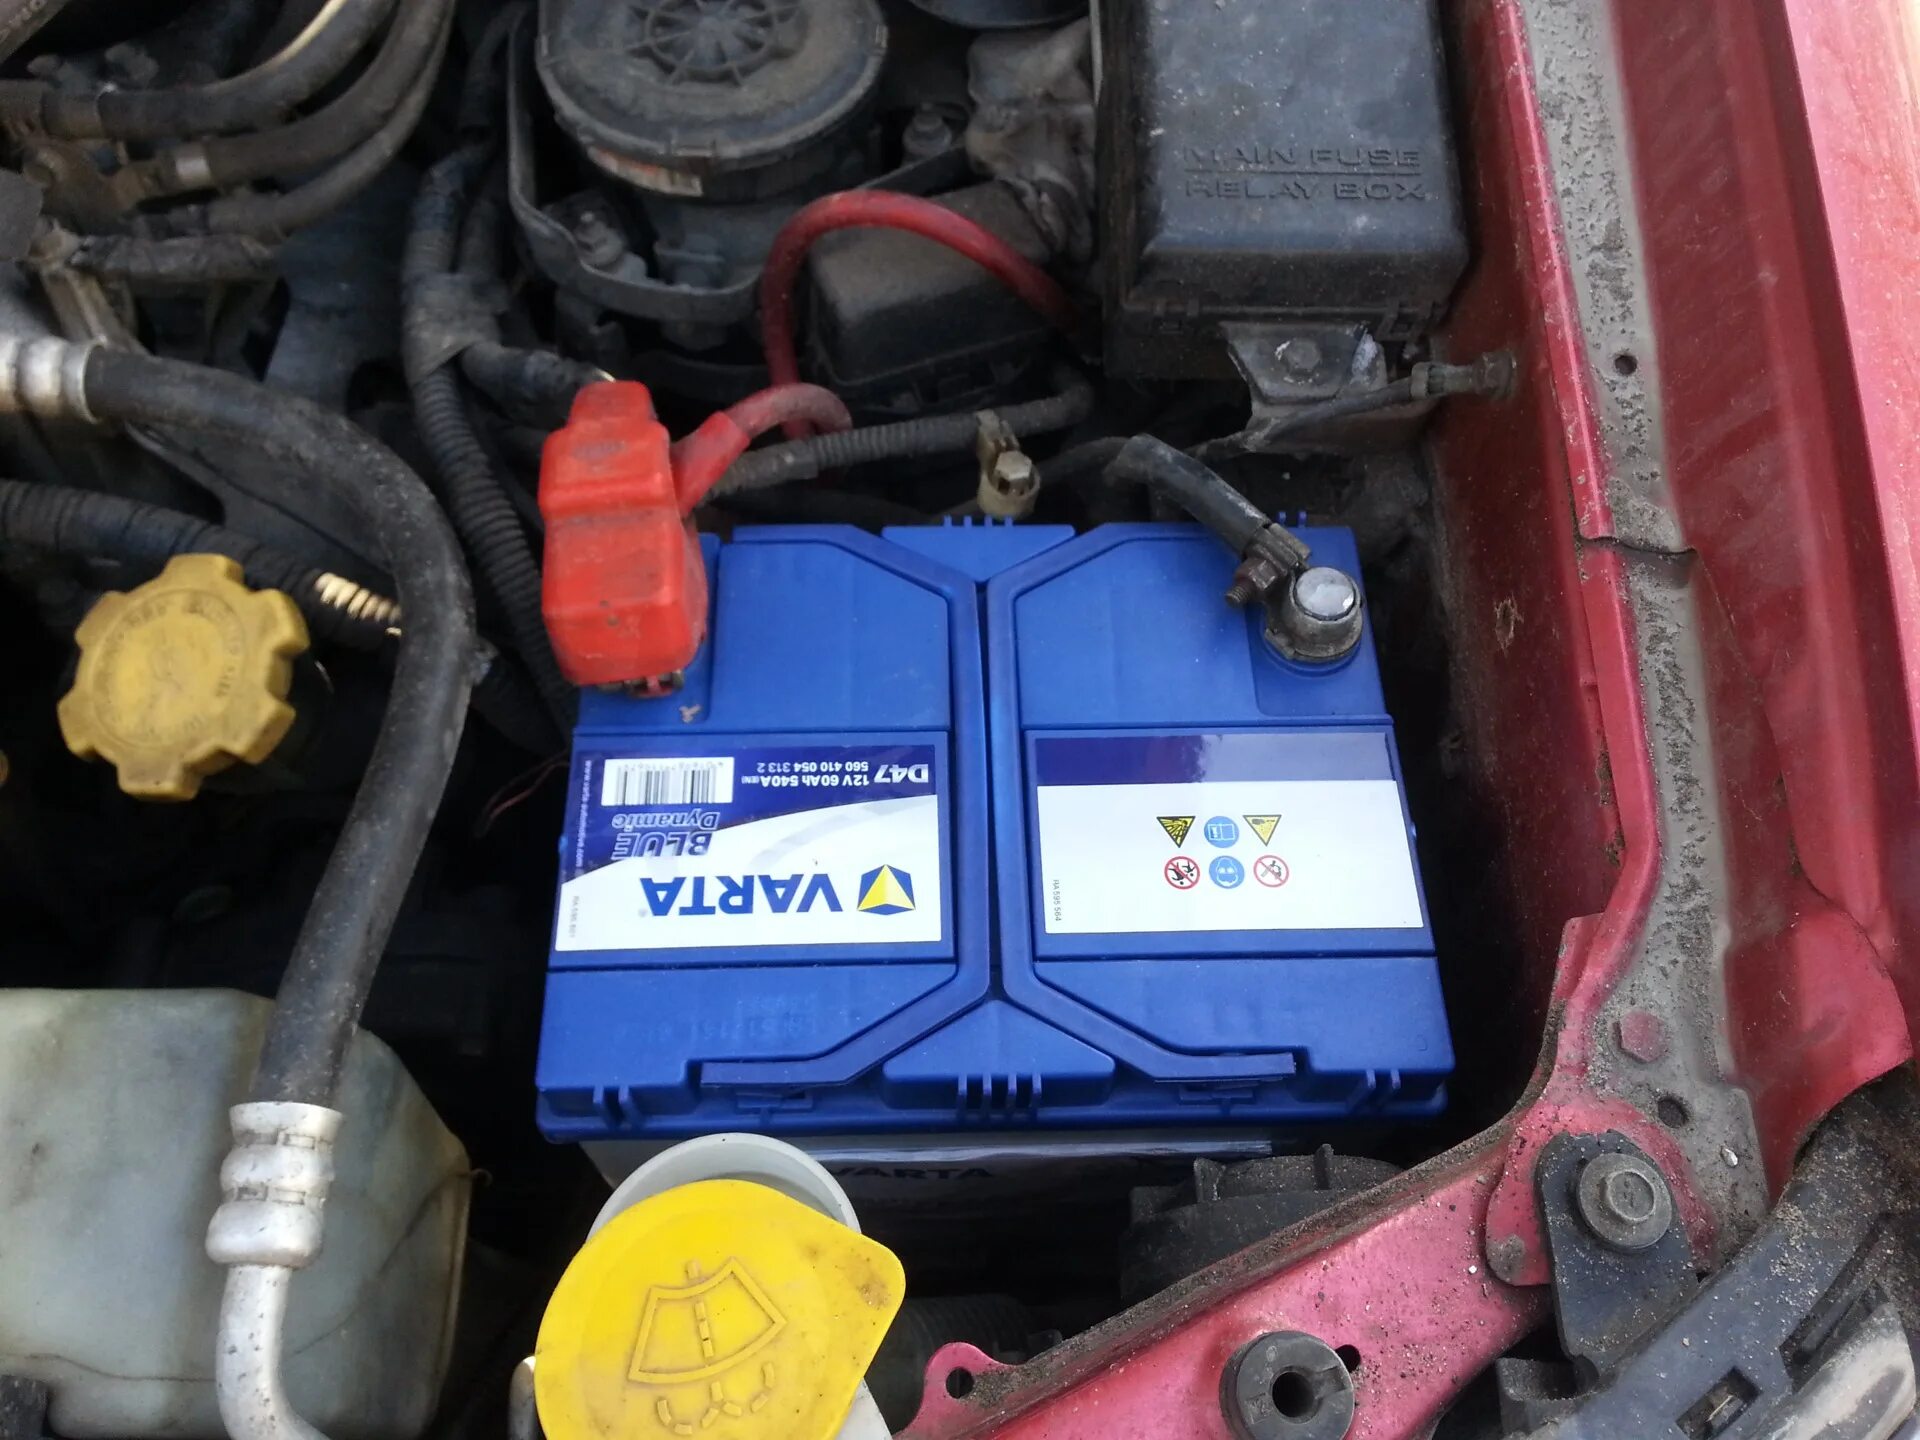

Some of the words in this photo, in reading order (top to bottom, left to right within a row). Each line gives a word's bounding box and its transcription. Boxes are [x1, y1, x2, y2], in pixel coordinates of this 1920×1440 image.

[1183, 146, 1296, 165] MAIN
[1310, 147, 1421, 167] FUSE
[1185, 179, 1318, 200] RELAY
[1334, 182, 1427, 201] BOX
[756, 762, 768, 773] 2
[769, 762, 791, 773] 313
[793, 761, 817, 773] 054
[819, 761, 843, 773] 410
[844, 761, 869, 773] 560
[874, 763, 930, 784] D47
[802, 773, 840, 786] 60Ah
[841, 773, 870, 786] 12V
[612, 809, 720, 831] Dynamic
[612, 831, 714, 860] BLUE
[638, 874, 843, 916] VARTA
